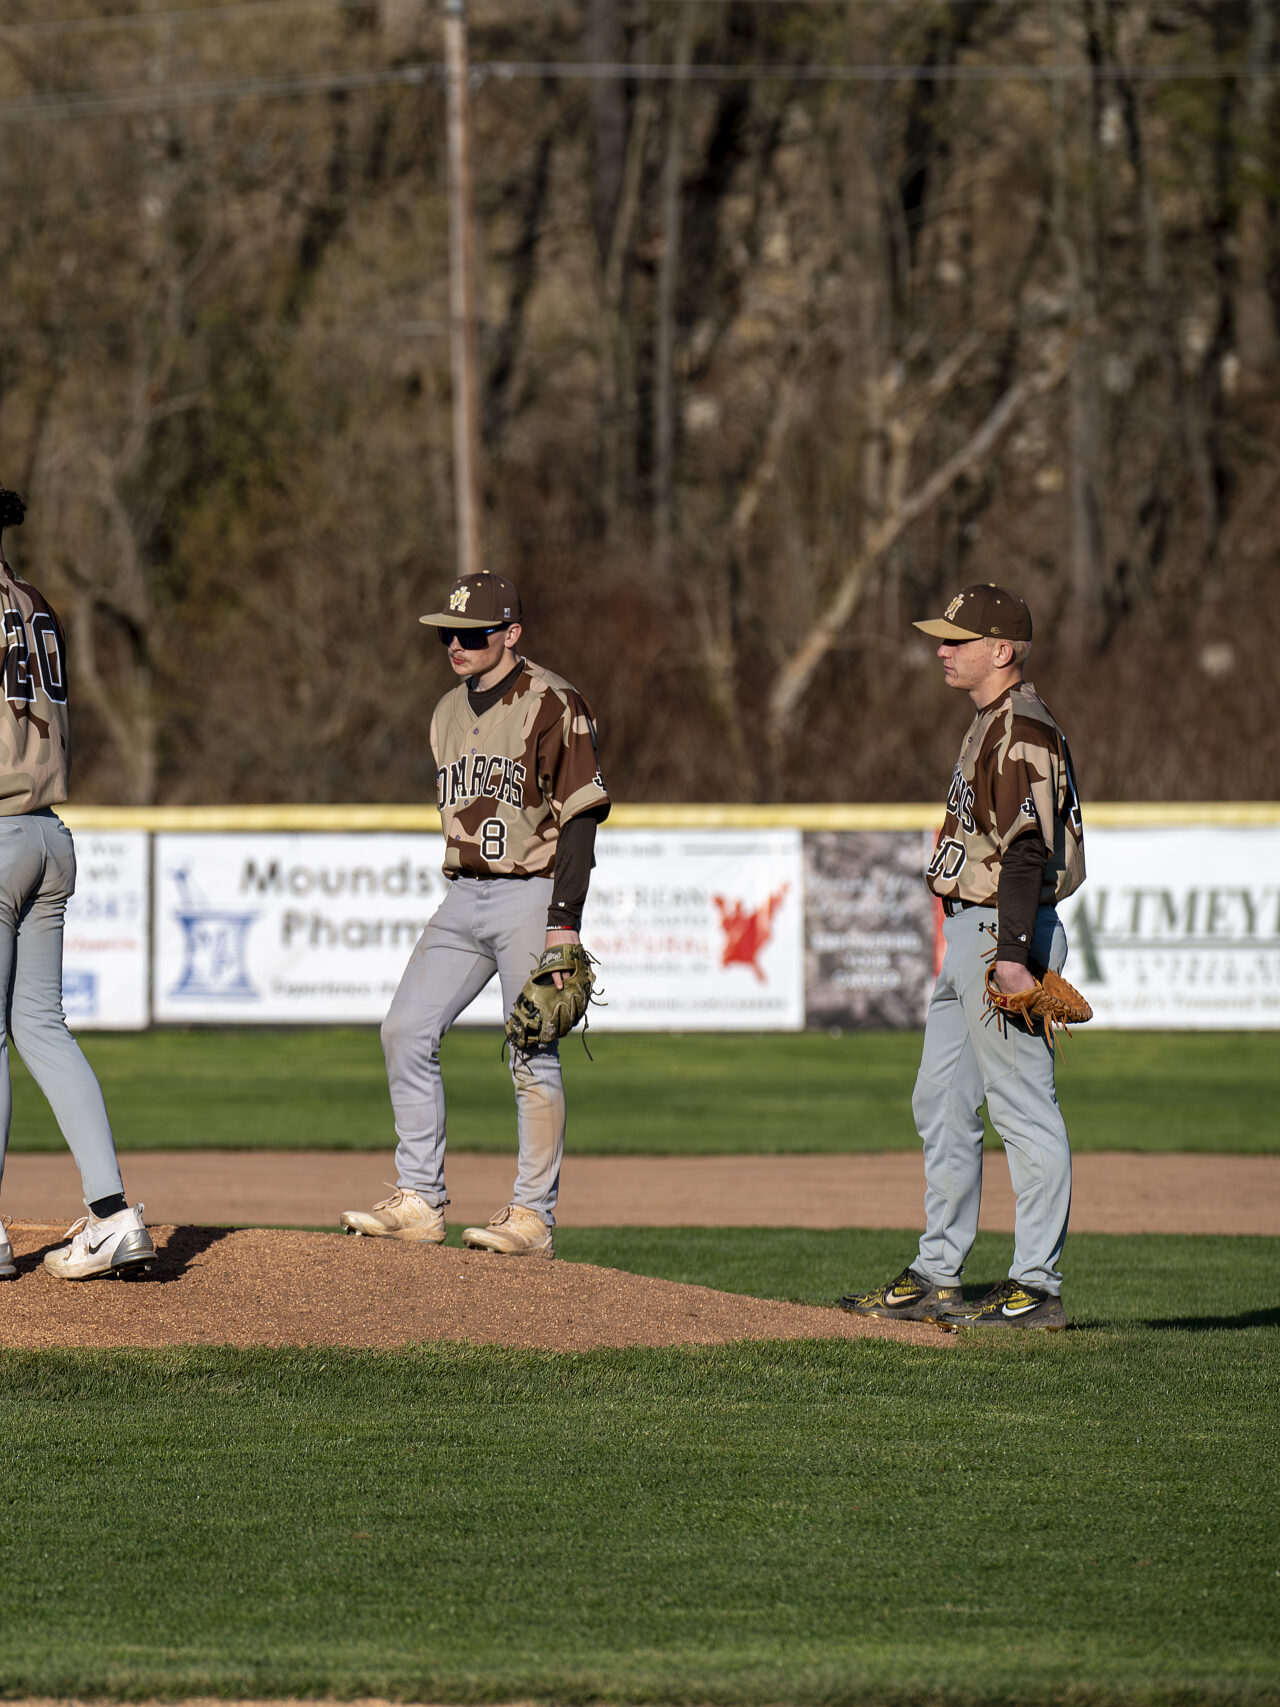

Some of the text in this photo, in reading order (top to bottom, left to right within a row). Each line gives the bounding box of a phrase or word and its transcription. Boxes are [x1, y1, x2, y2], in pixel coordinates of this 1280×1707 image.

[1, 608, 67, 704] 20
[480, 817, 507, 862] 8
[927, 838, 967, 881] 10
[280, 908, 426, 951] Pharm
